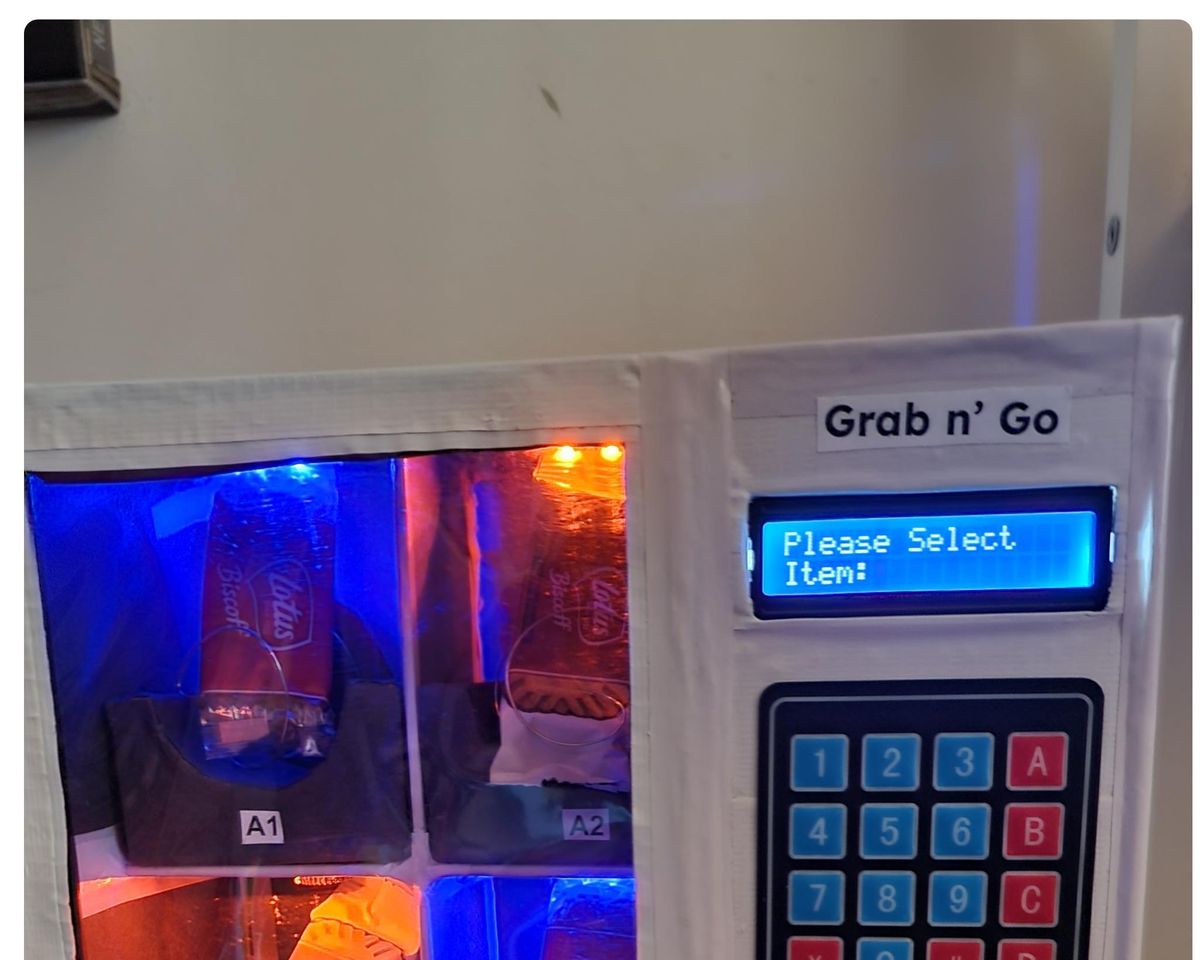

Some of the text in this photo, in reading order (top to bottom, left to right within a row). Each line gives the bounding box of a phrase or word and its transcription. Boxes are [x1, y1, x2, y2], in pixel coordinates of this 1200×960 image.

[825, 402, 929, 437] Grab
[1000, 401, 1059, 435] Go
[784, 525, 1017, 557] Please Select
[785, 561, 867, 587] Item:
[814, 746, 1048, 777] 1 2 3 A
[246, 816, 279, 837] A1
[569, 815, 604, 836] A2
[808, 816, 1046, 846] 4 5 6 B
[809, 883, 1042, 914] 7 8 9 C
